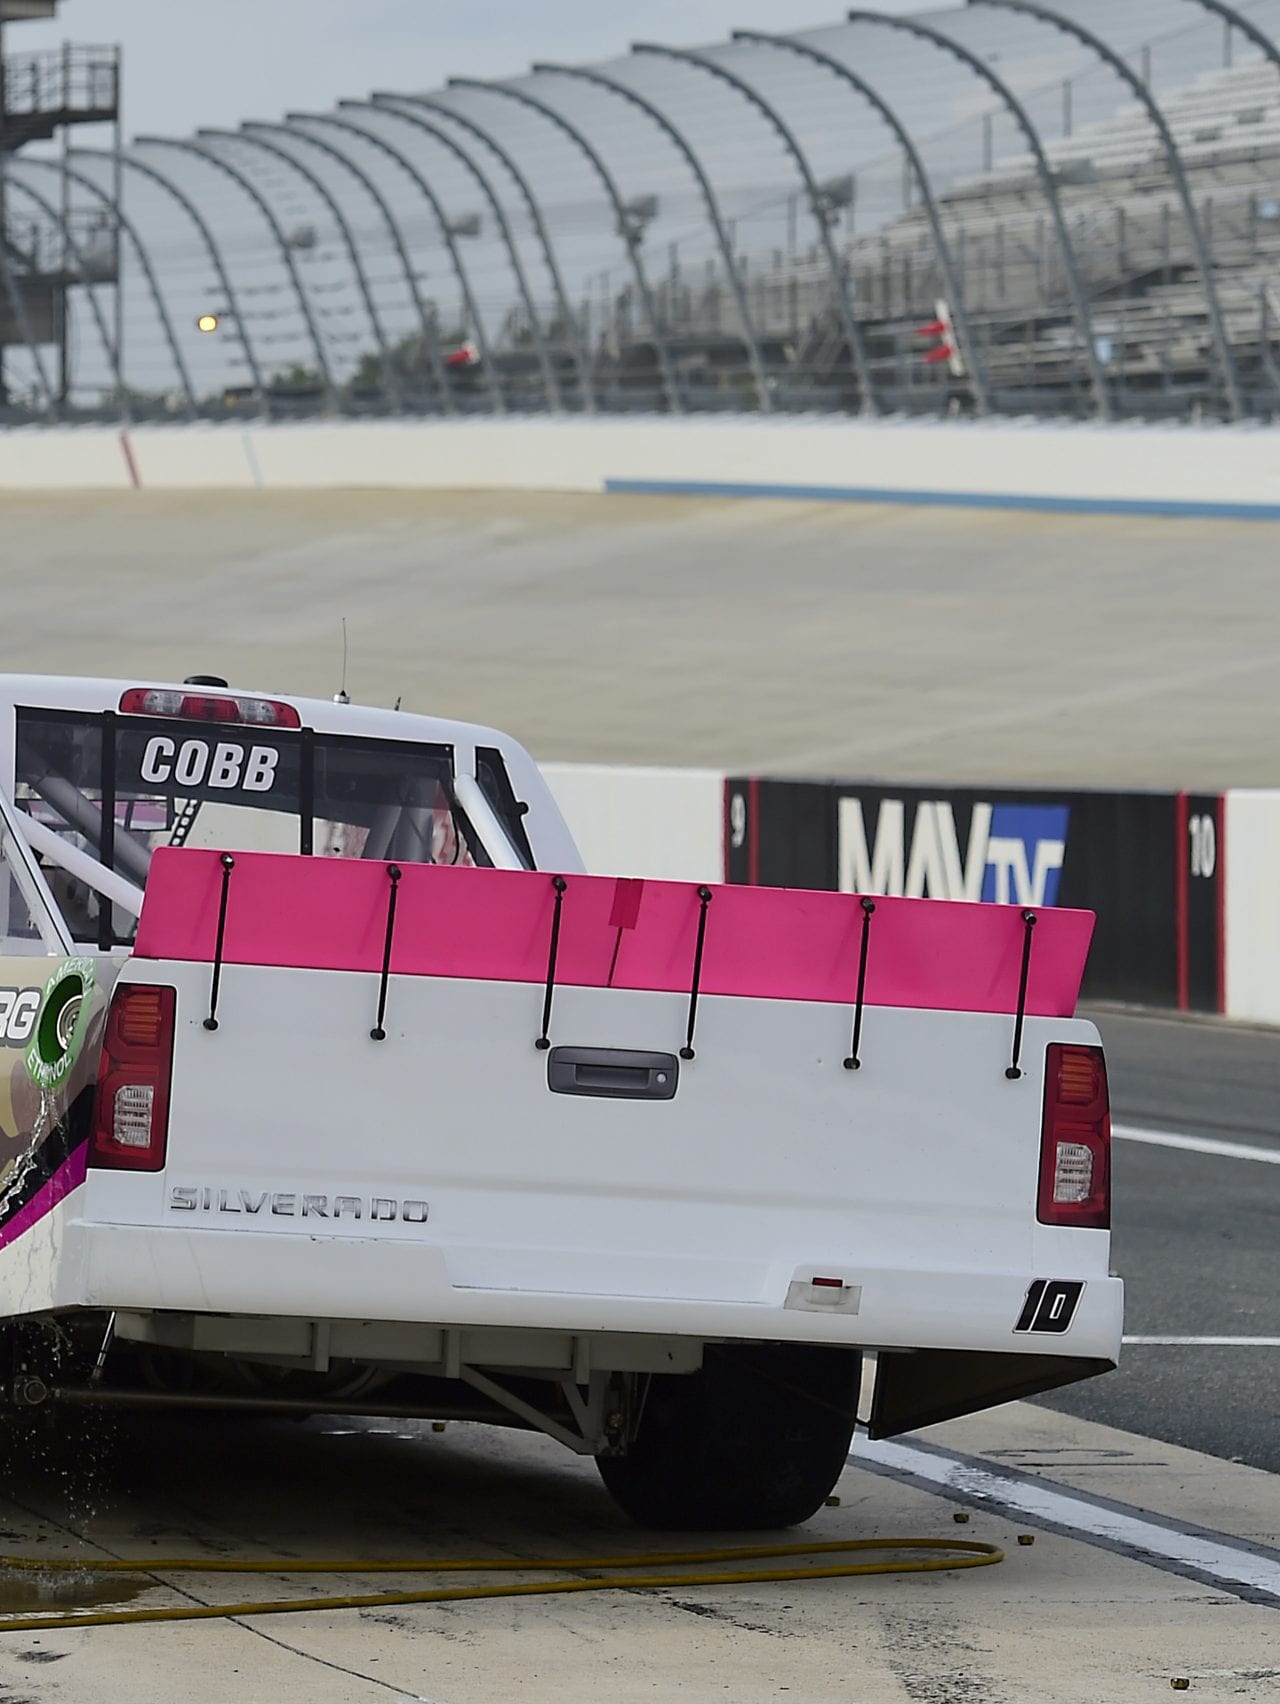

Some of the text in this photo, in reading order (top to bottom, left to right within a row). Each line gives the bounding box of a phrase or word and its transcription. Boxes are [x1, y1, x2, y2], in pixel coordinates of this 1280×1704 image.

[141, 737, 279, 792] COBB
[730, 794, 746, 848] 9
[1189, 814, 1217, 879] 10
[170, 1186, 429, 1223] SILVERADO
[1012, 1277, 1087, 1336] 10
